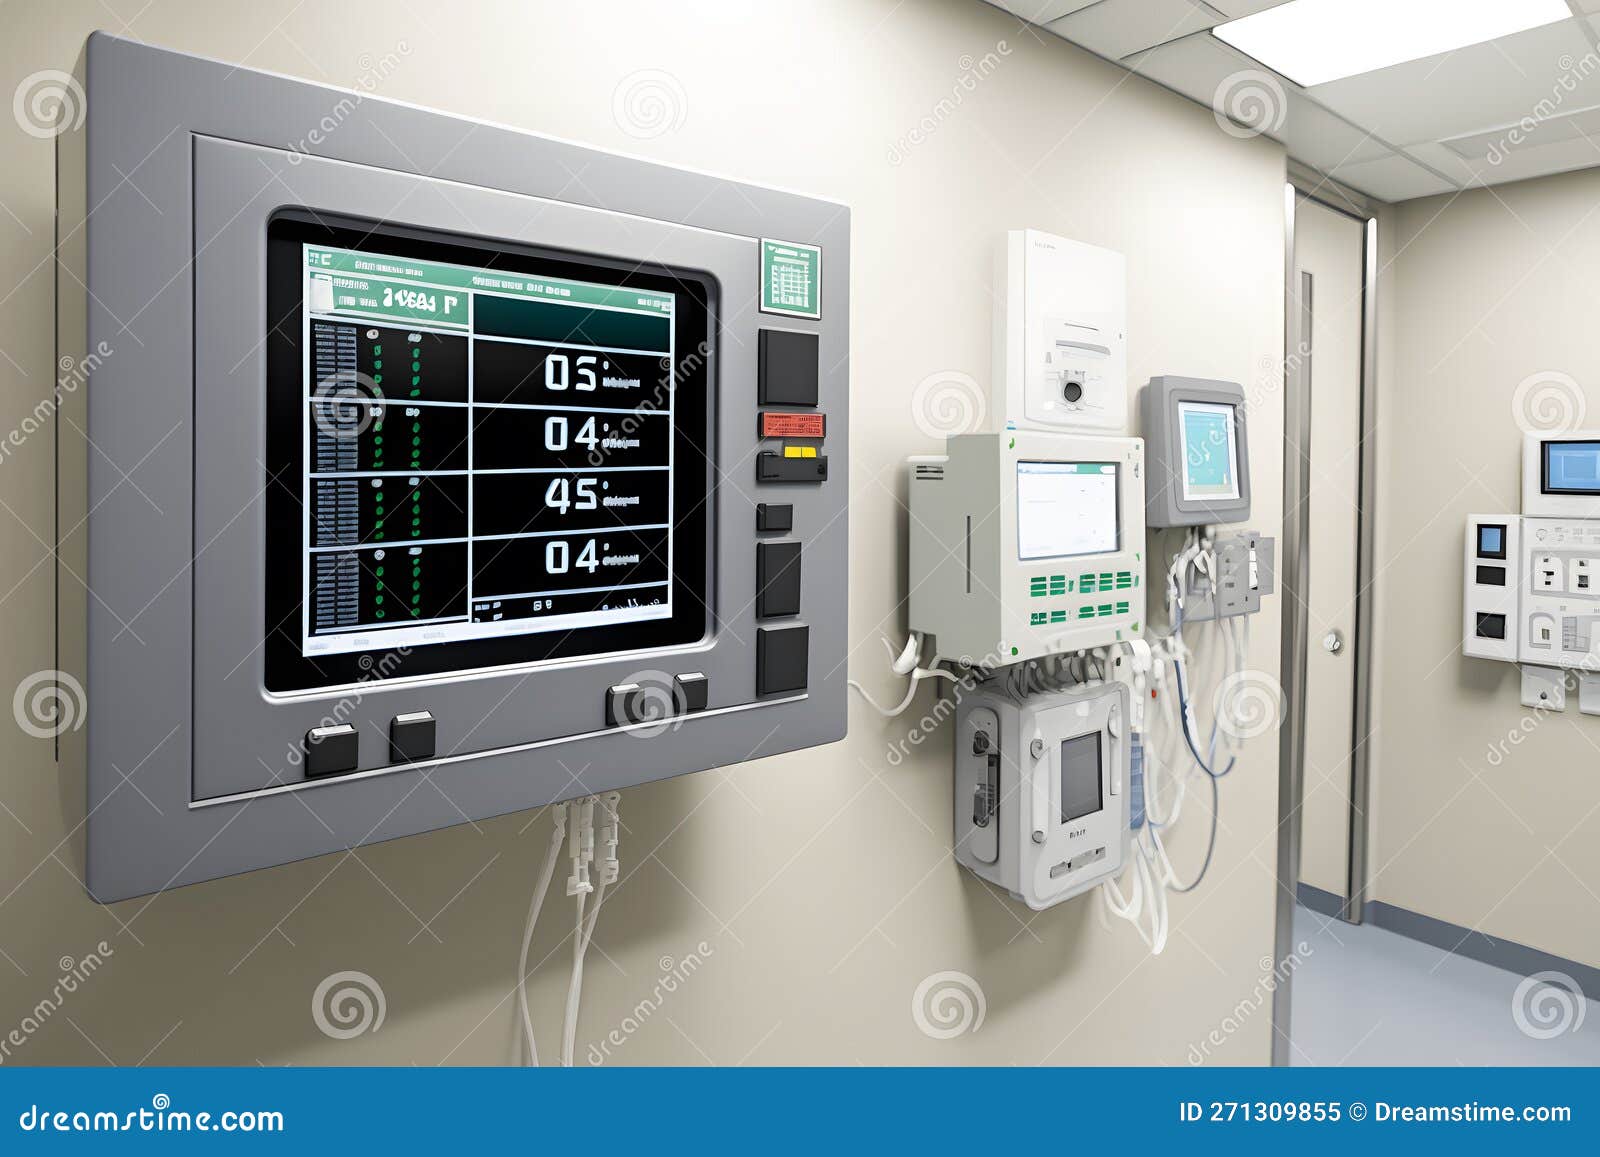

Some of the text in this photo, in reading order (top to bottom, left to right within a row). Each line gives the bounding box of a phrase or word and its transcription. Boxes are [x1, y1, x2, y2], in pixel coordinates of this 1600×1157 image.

[545, 354, 597, 391] 05
[545, 416, 600, 451] 04
[545, 478, 598, 515] 45
[545, 539, 600, 574] 04
